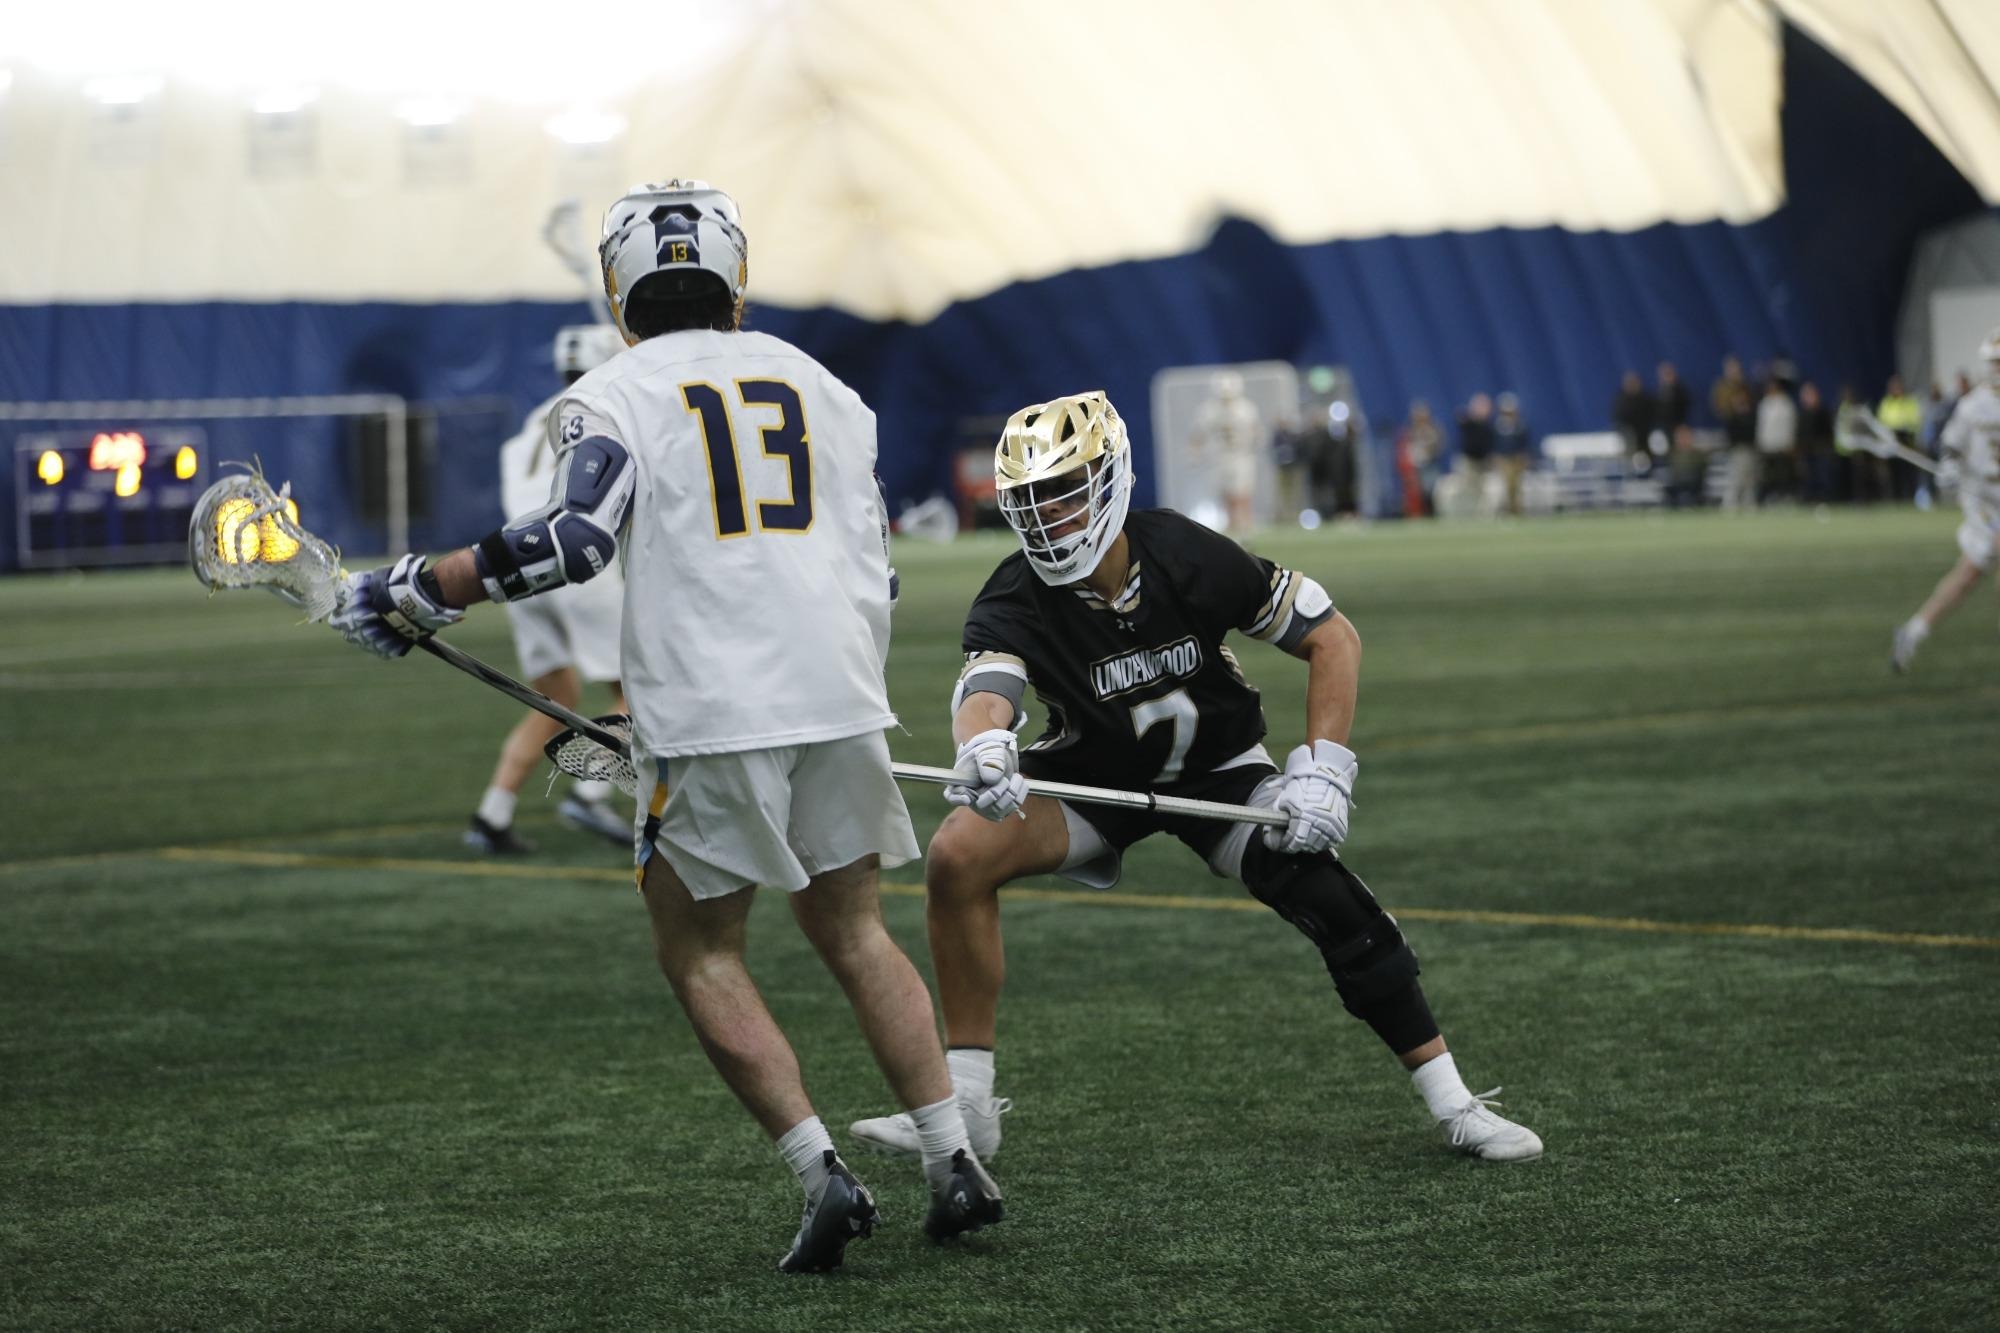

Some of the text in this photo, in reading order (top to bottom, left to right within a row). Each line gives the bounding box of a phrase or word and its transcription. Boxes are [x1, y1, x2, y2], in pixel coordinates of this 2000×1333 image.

[671, 242, 688, 262] 13
[560, 415, 584, 445] 13
[678, 377, 815, 541] 13
[382, 609, 430, 641] STX
[1096, 640, 1197, 696] LINDENWOOD
[1130, 687, 1199, 784] 7
